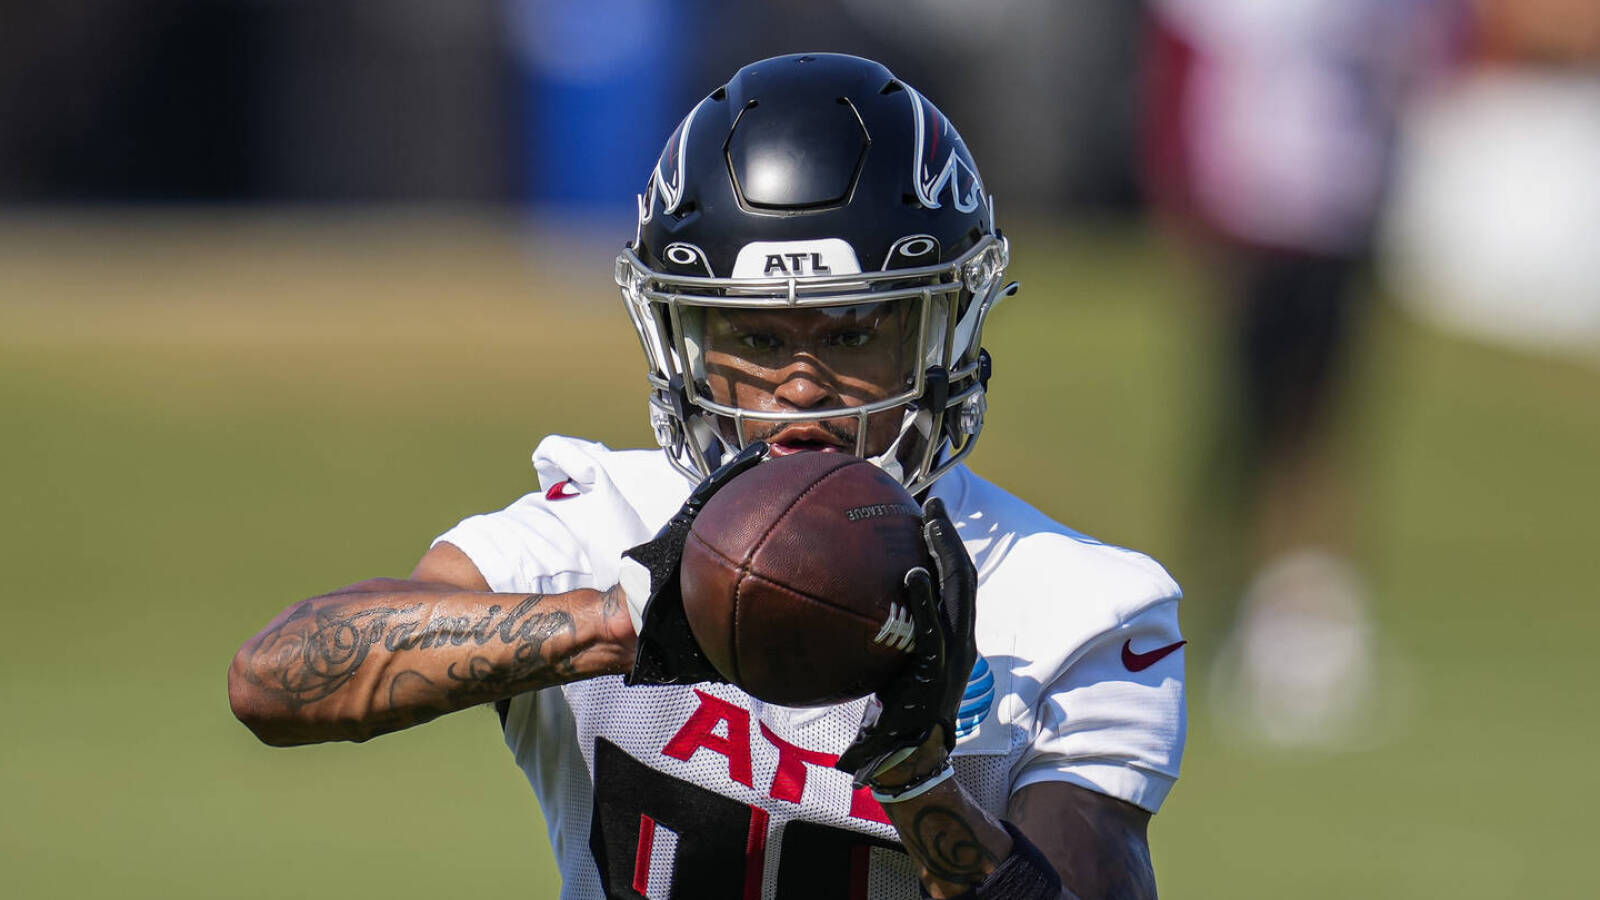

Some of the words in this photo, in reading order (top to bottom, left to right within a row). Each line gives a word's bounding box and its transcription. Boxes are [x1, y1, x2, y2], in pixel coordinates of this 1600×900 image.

[764, 252, 831, 275] ATL
[846, 504, 888, 521] LEAGUE
[298, 594, 577, 690] Family
